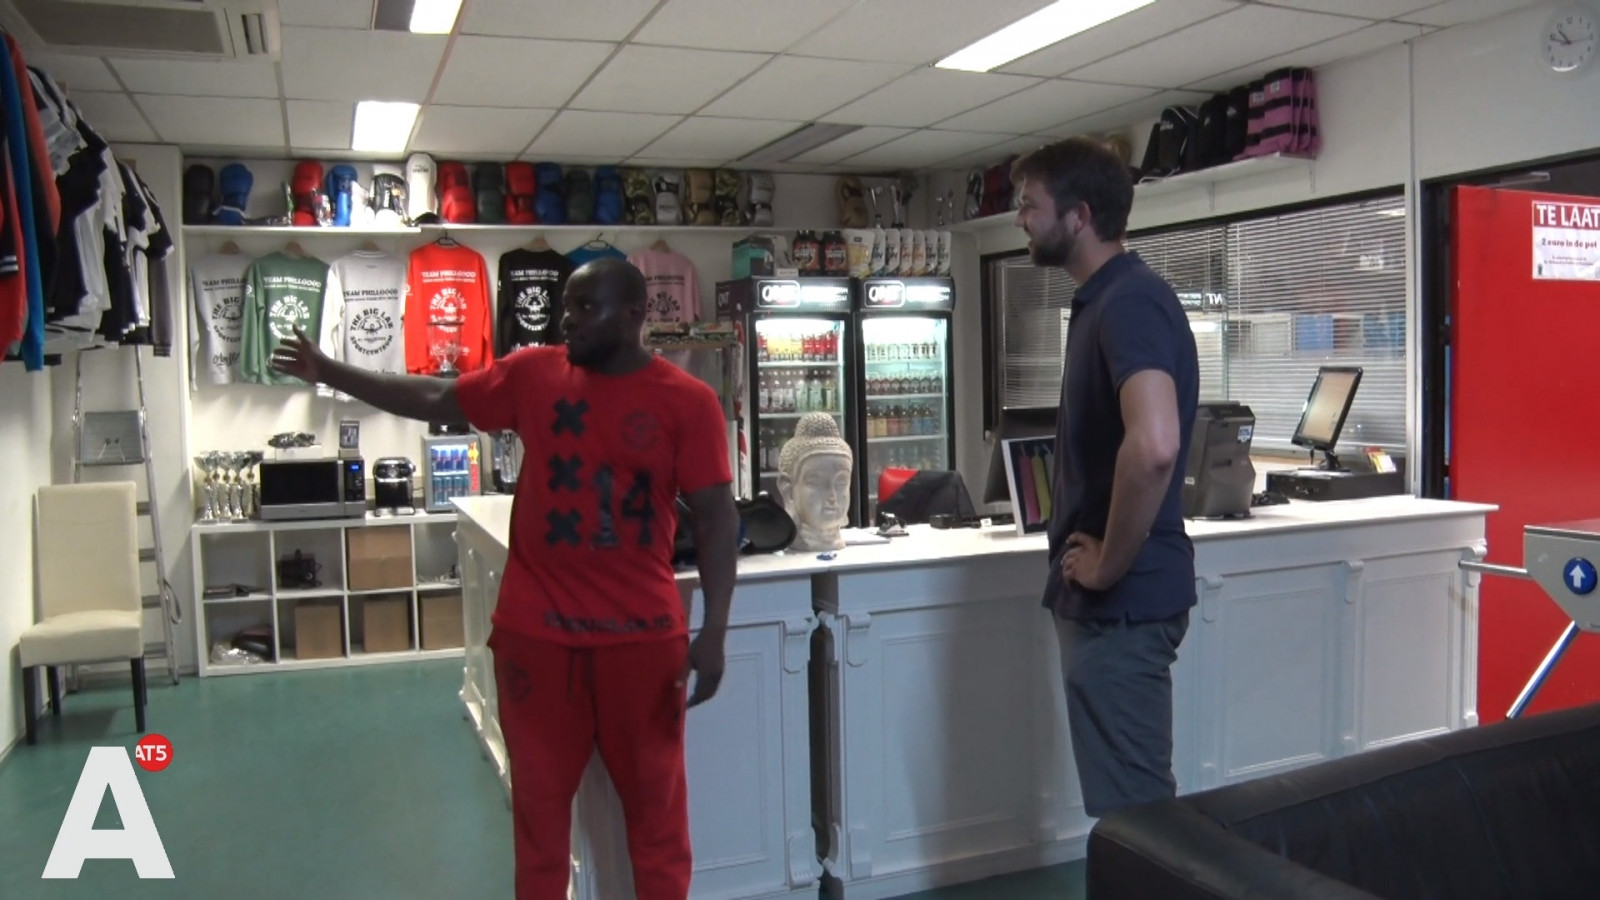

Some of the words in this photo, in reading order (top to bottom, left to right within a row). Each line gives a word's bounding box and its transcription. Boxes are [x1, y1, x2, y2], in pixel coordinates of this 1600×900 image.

[1536, 204, 1557, 225] TE
[1560, 205, 1600, 228] LAAT
[1541, 238, 1546, 246] 2
[1547, 239, 1565, 247] euro
[1566, 239, 1573, 247] in
[1574, 239, 1584, 248] de
[1584, 240, 1597, 250] pot
[362, 307, 379, 317] BIG
